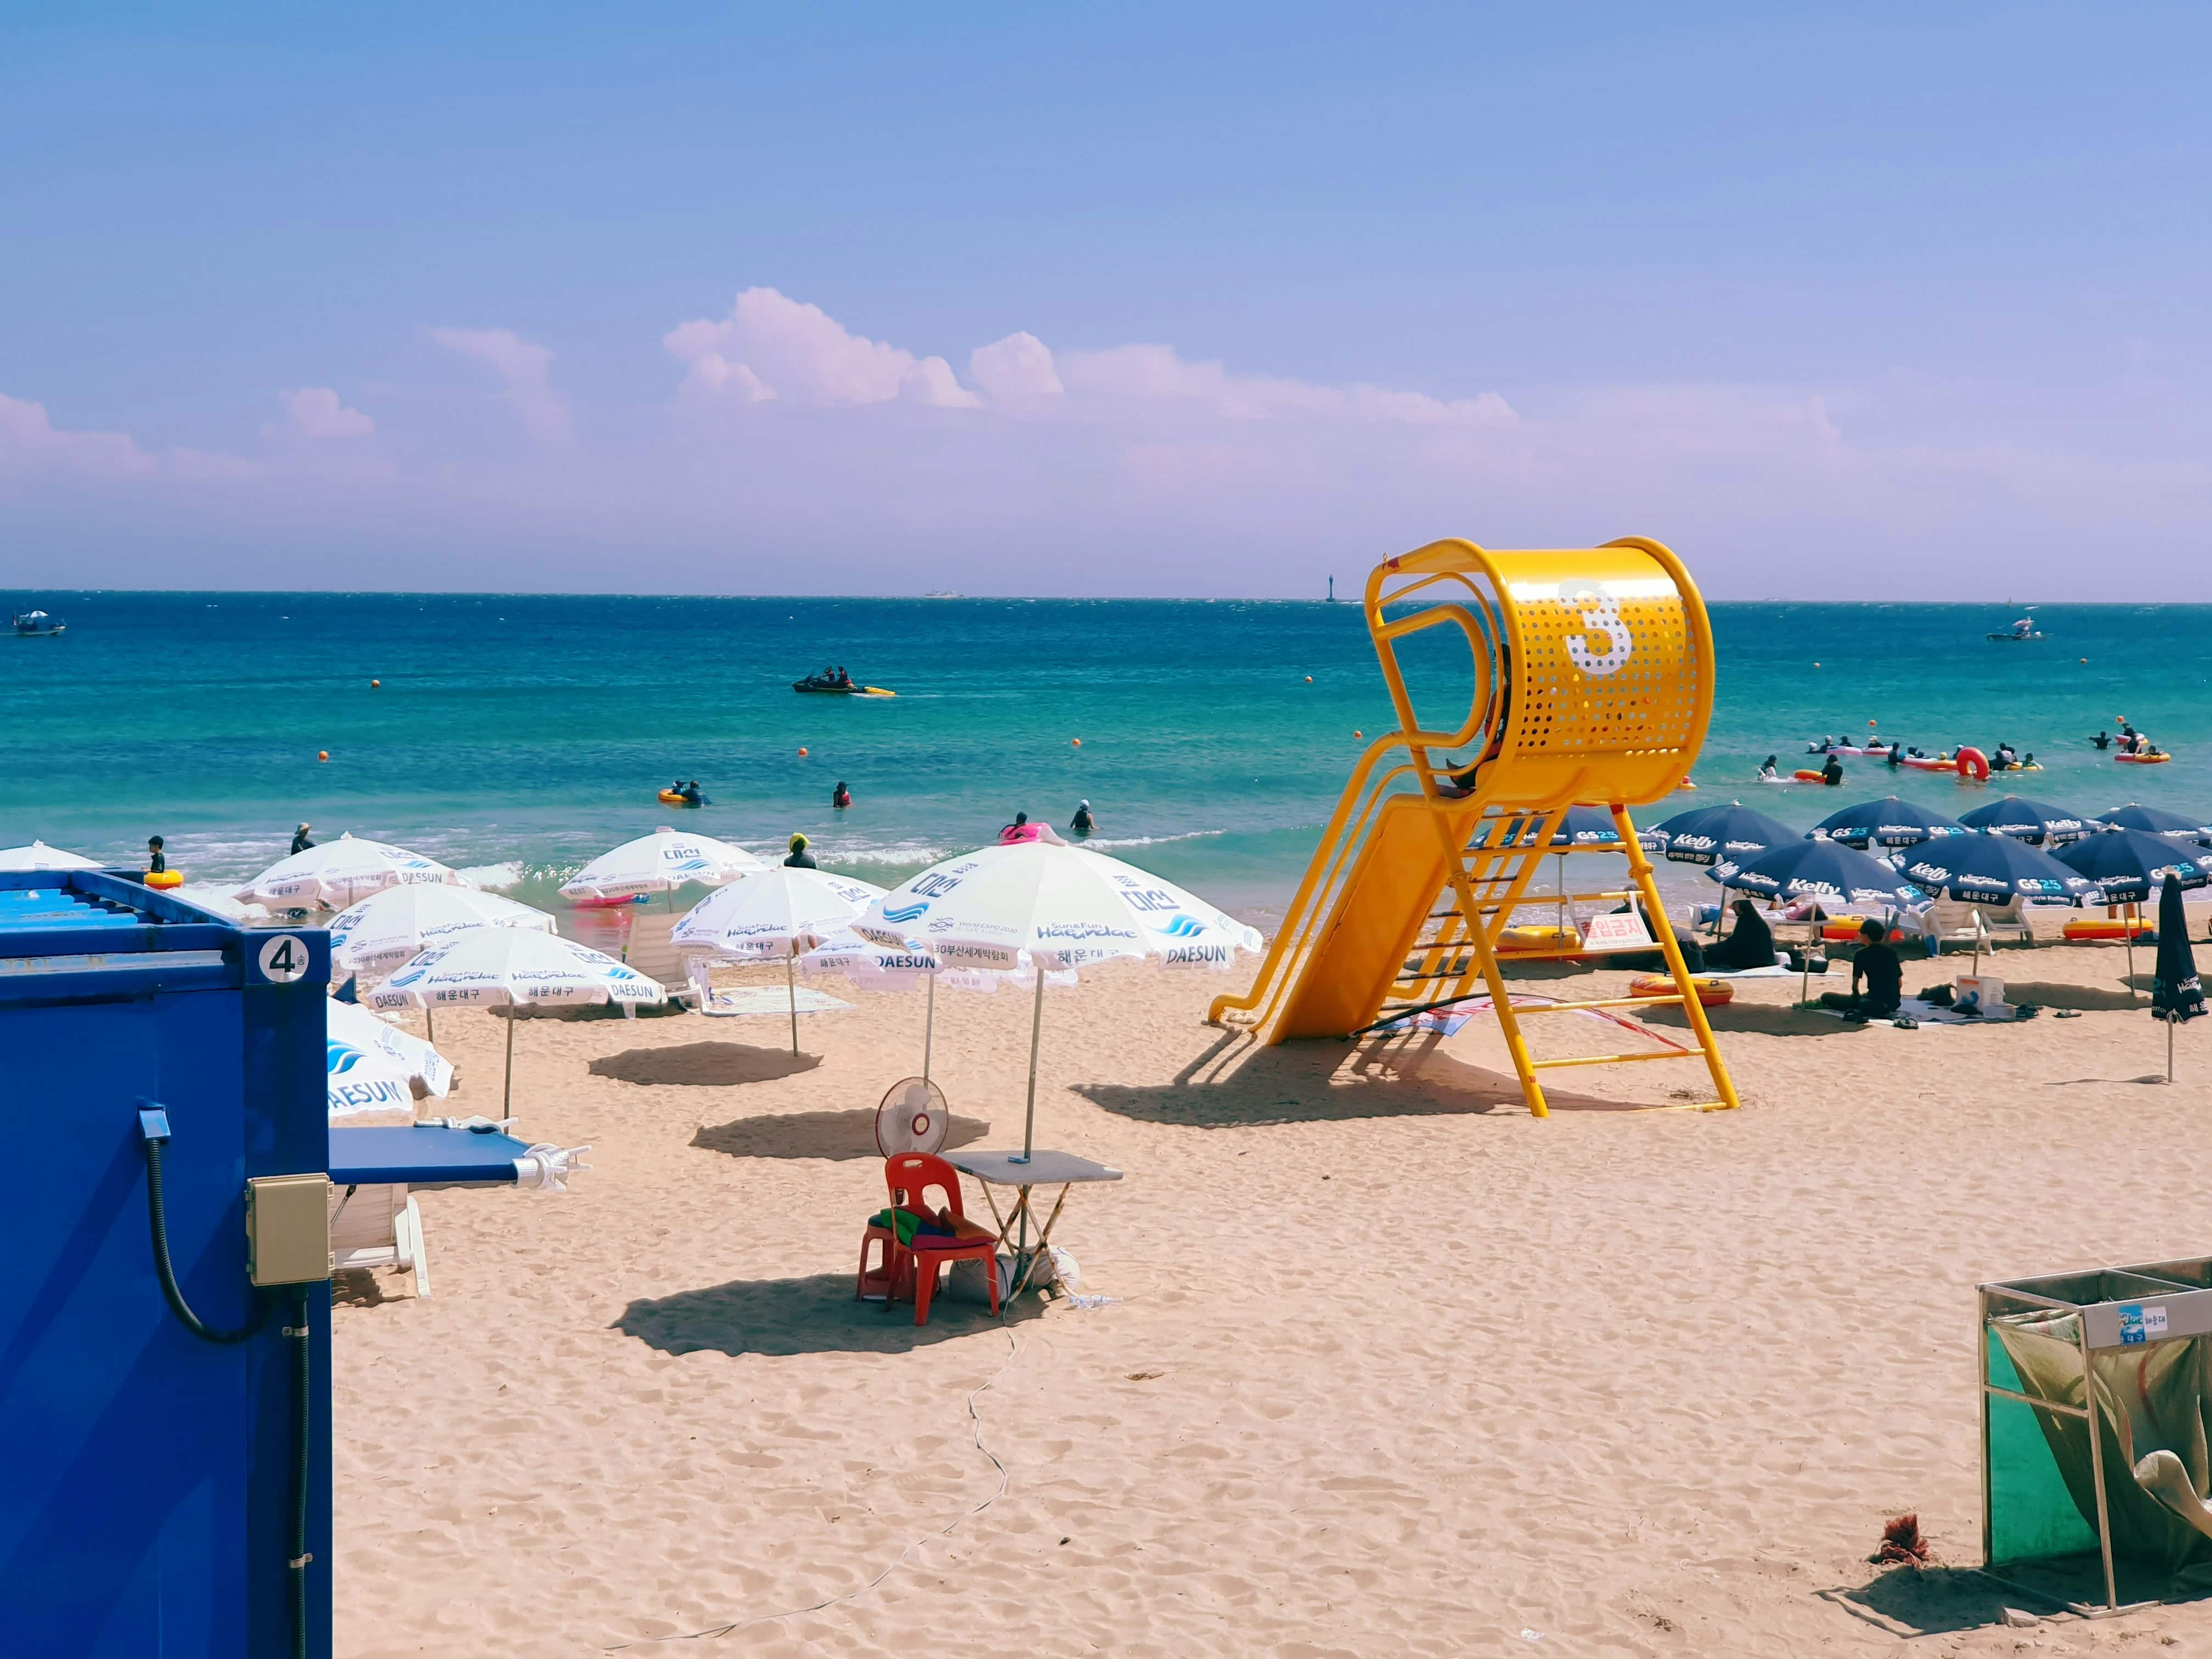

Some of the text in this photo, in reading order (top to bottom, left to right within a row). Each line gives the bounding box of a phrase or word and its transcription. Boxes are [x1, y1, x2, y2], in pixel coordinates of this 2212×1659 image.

[1558, 579, 1632, 675] 3
[1577, 831, 1619, 840] GS25
[1832, 827, 1869, 837] GS25
[1673, 833, 1717, 849] Kelly
[1909, 862, 1952, 881] Kelly
[1787, 878, 1841, 896] Kelly
[2018, 879, 2062, 889] GS25
[1962, 890, 1999, 901] 해운대구
[269, 939, 295, 973] 4
[934, 943, 1009, 962] 30부산세계박람회
[1166, 945, 1226, 964] DAESUN
[876, 955, 935, 969] DAESUN
[436, 989, 481, 1001] 해운대구
[528, 986, 574, 997] 해운대구
[611, 984, 653, 997] DAESUN
[375, 994, 409, 1008] DAESUN
[328, 1081, 403, 1108] AESUN
